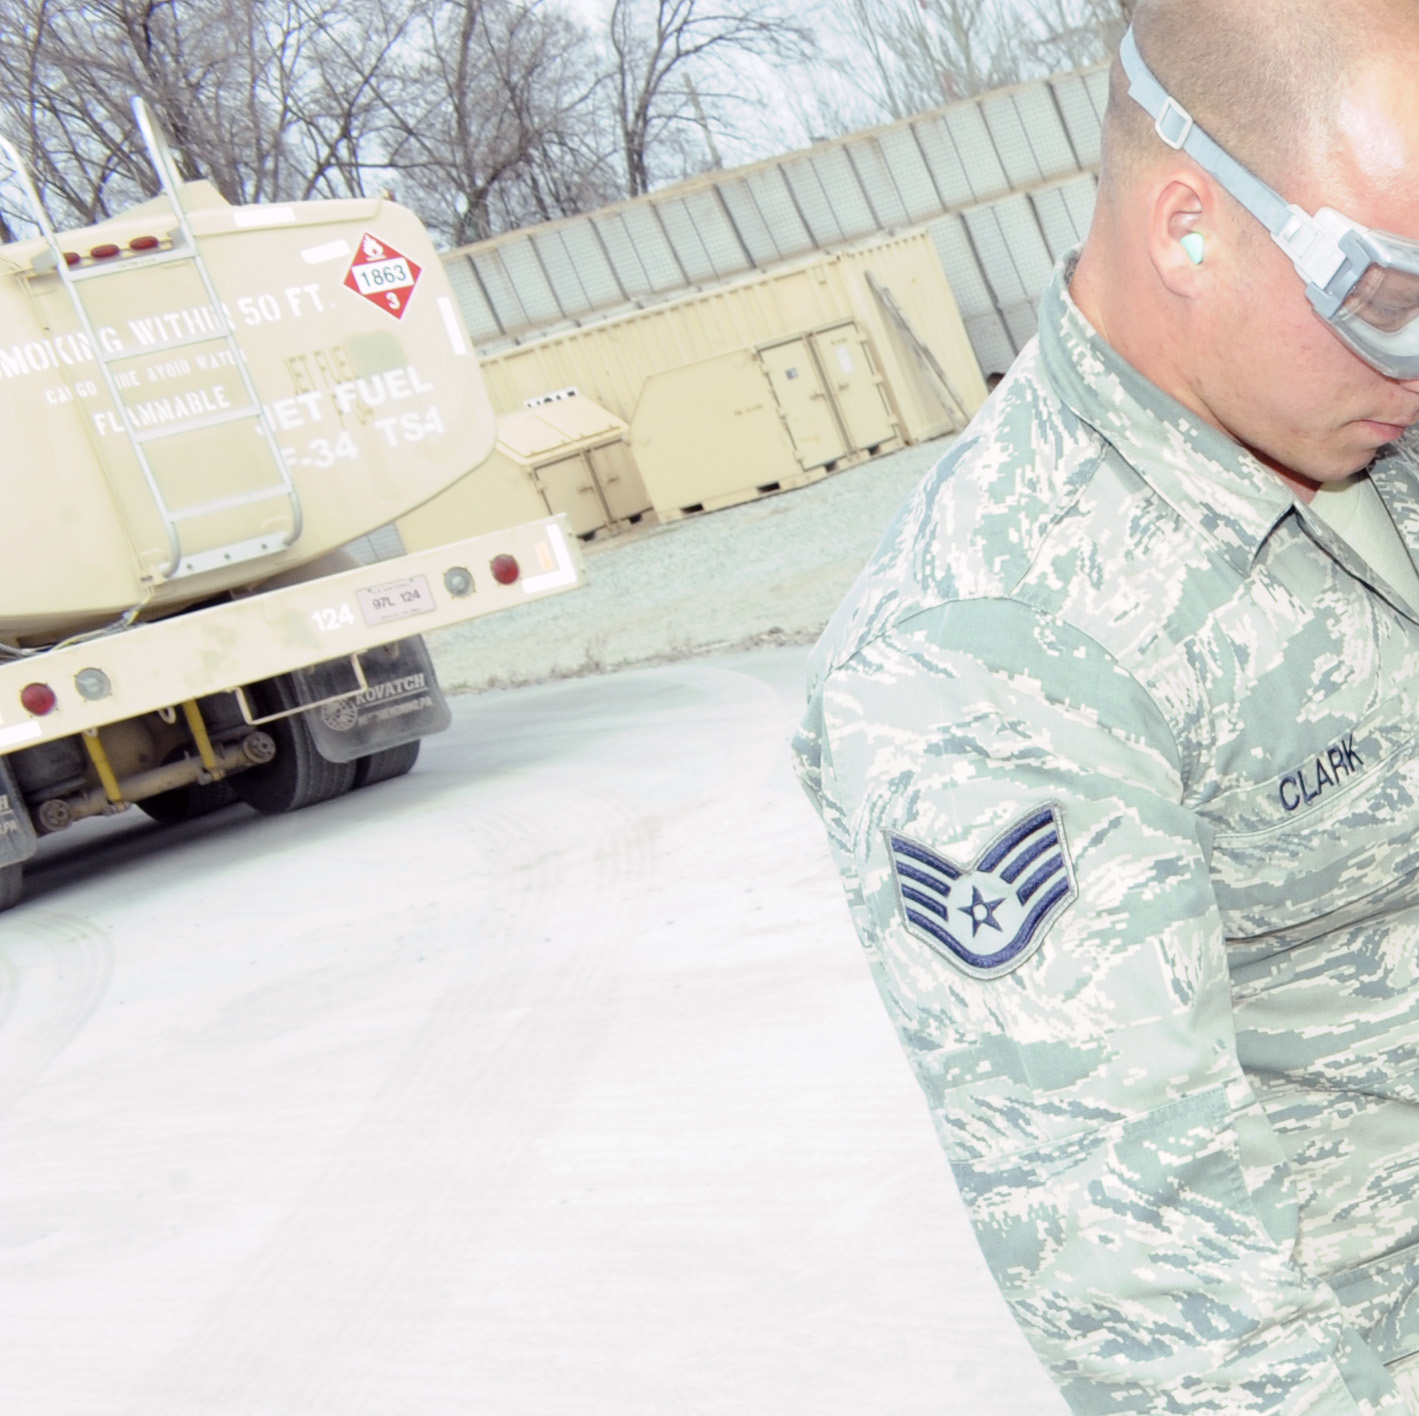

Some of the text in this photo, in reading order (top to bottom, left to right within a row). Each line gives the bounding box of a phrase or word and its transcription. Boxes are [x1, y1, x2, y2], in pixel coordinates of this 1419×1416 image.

[359, 264, 407, 288] 1863
[385, 291, 401, 310] 3
[0, 326, 125, 379] MOKING
[237, 293, 281, 326] 50
[113, 369, 142, 390] IRE
[333, 365, 434, 414] FUEL
[93, 384, 232, 437] FLAMMABLE
[312, 604, 354, 632] 124
[1279, 733, 1364, 811] CLARK
